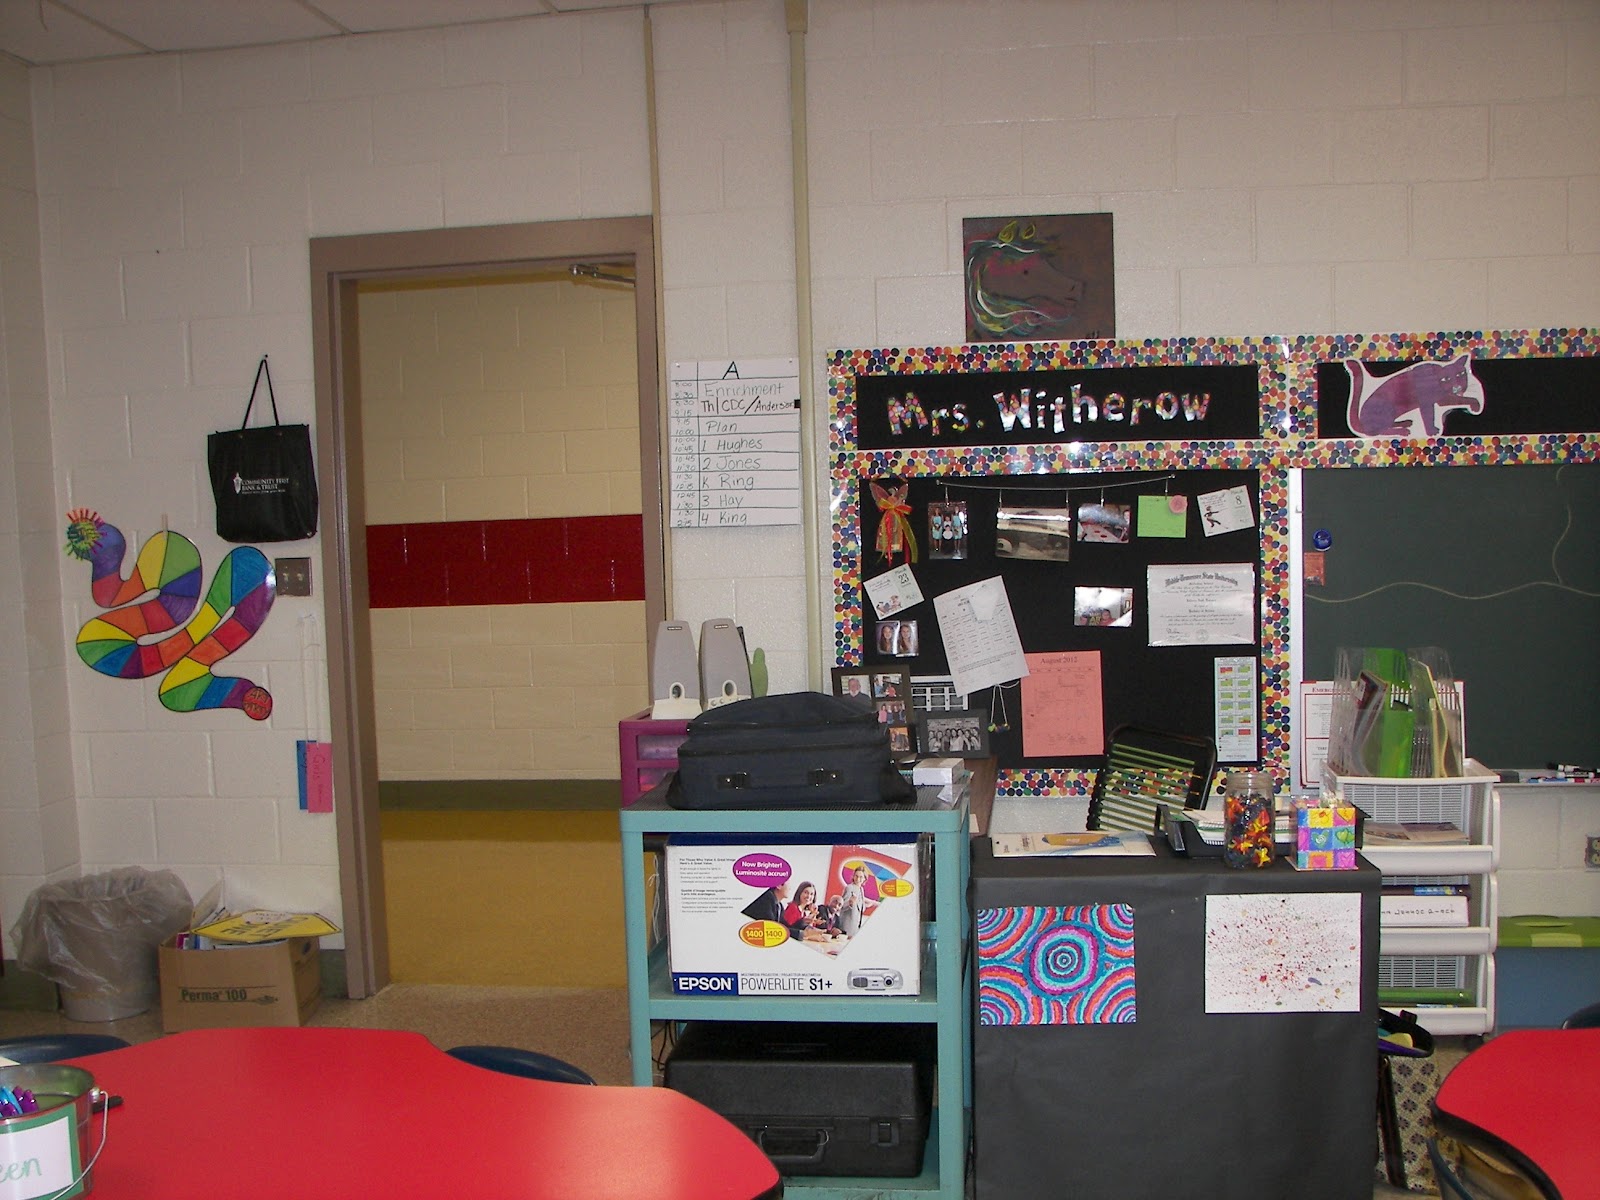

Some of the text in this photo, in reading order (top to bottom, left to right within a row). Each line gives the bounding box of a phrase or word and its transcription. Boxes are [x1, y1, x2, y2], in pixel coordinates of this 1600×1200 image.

[722, 361, 740, 380] A
[704, 382, 785, 398] Enrichment
[887, 384, 1210, 436] Mrs. Witherow
[706, 420, 738, 433] Plan
[701, 438, 764, 453] 1 Hughes
[702, 454, 762, 470] 2 Jones
[719, 473, 755, 490] Ring
[701, 494, 744, 508] 3 Hay
[1235, 495, 1243, 505] 8
[701, 512, 748, 526] 4 King
[898, 573, 910, 585] 23
[1040, 657, 1062, 666] August
[757, 861, 782, 869] Brighter!
[746, 930, 764, 938] 1400
[766, 930, 783, 938] 1400
[679, 977, 833, 991] EPSON POWERLITE S1+
[181, 989, 248, 1001] Perma 100
